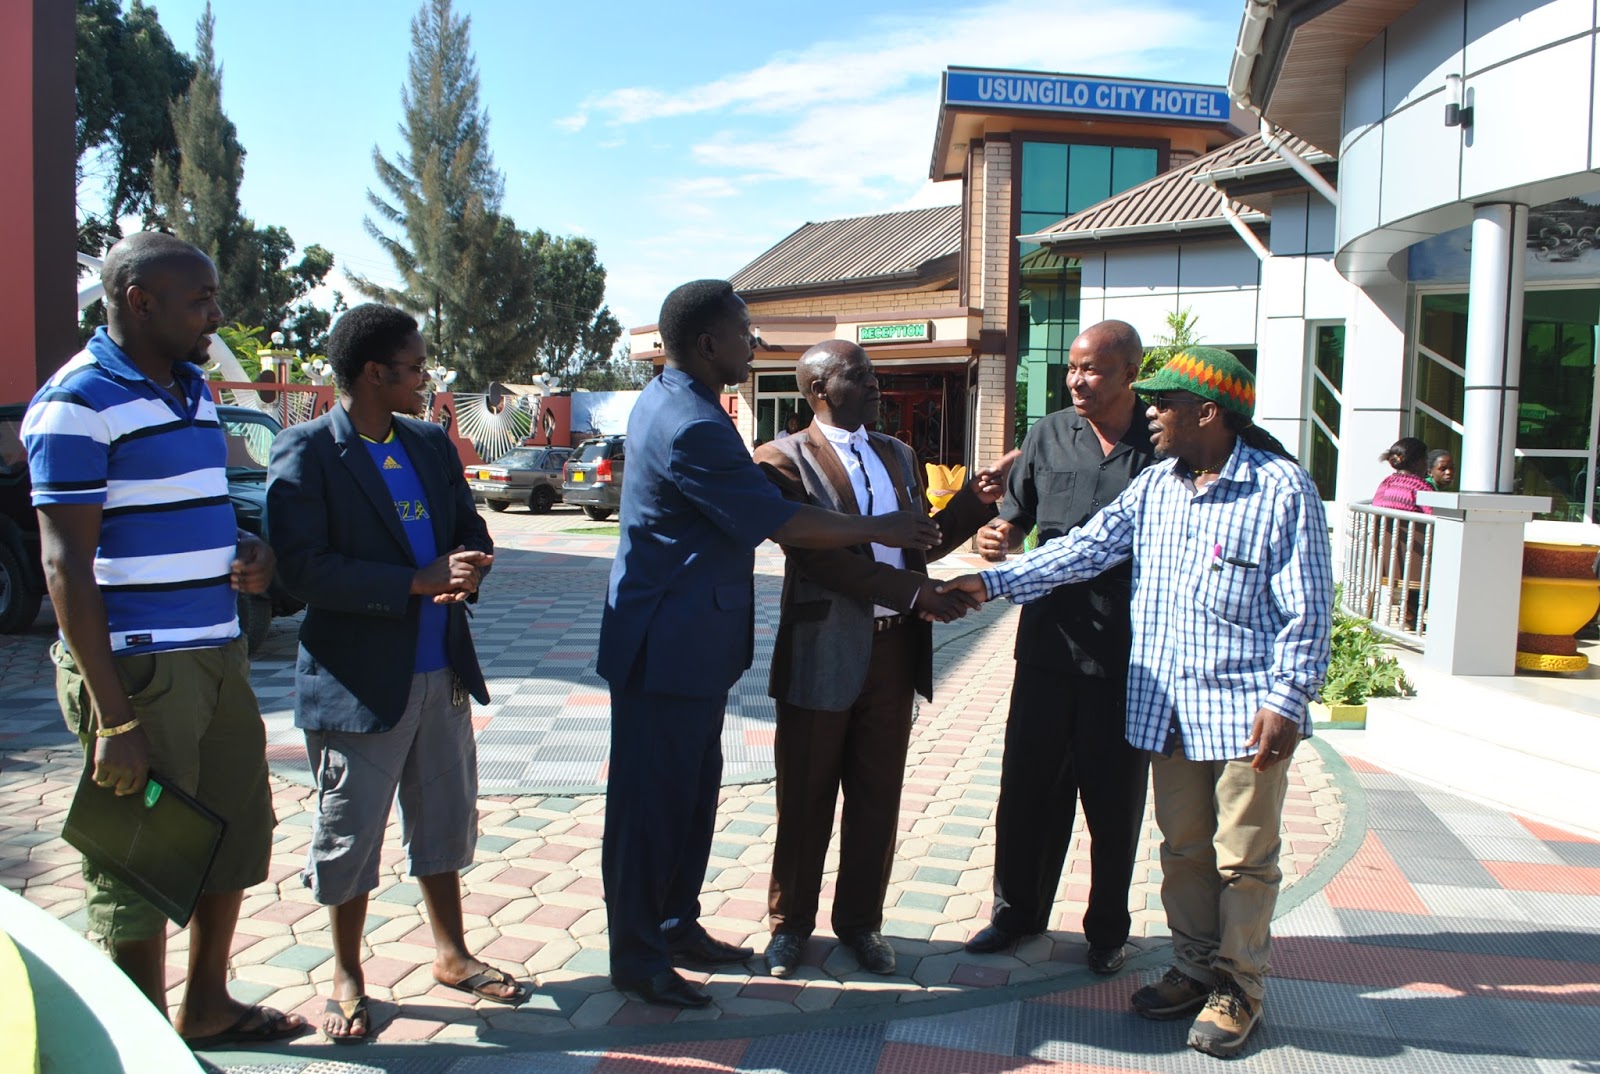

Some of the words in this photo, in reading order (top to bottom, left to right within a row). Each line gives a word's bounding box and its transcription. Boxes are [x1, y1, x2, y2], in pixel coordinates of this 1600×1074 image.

[977, 77, 1089, 106] USUNGILO
[1095, 85, 1146, 111] CITY
[1151, 89, 1221, 117] HOTEL
[860, 324, 925, 340] RECEPTION
[394, 499, 430, 521] ZA
